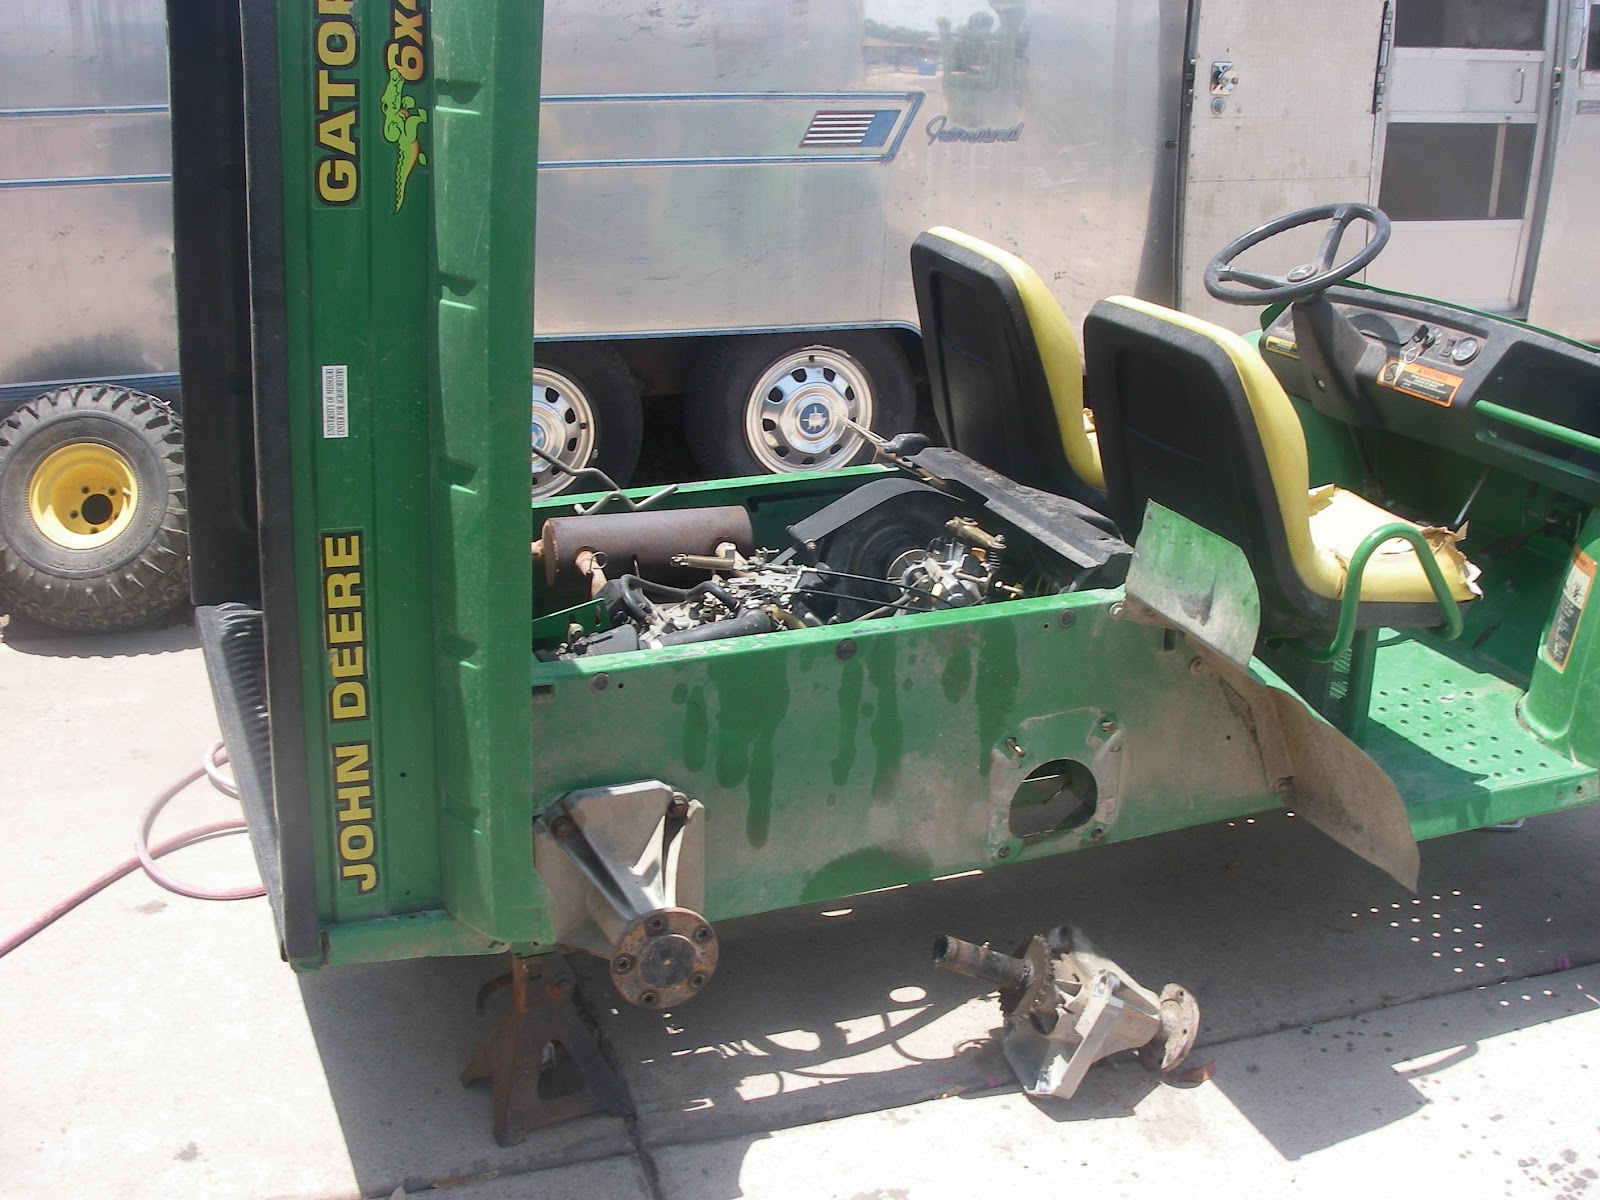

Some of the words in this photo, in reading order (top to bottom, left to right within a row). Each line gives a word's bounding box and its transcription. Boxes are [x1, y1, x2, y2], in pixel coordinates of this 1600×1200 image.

[387, 0, 424, 81] 6x
[325, 368, 335, 395] MISSOURI
[335, 368, 345, 404] AGROFORESTRY
[326, 404, 336, 436] UNIVERSITY
[336, 405, 345, 416] FOR
[336, 416, 345, 436] CENTER
[324, 534, 367, 721] DEERE
[335, 744, 378, 892] JOHN
